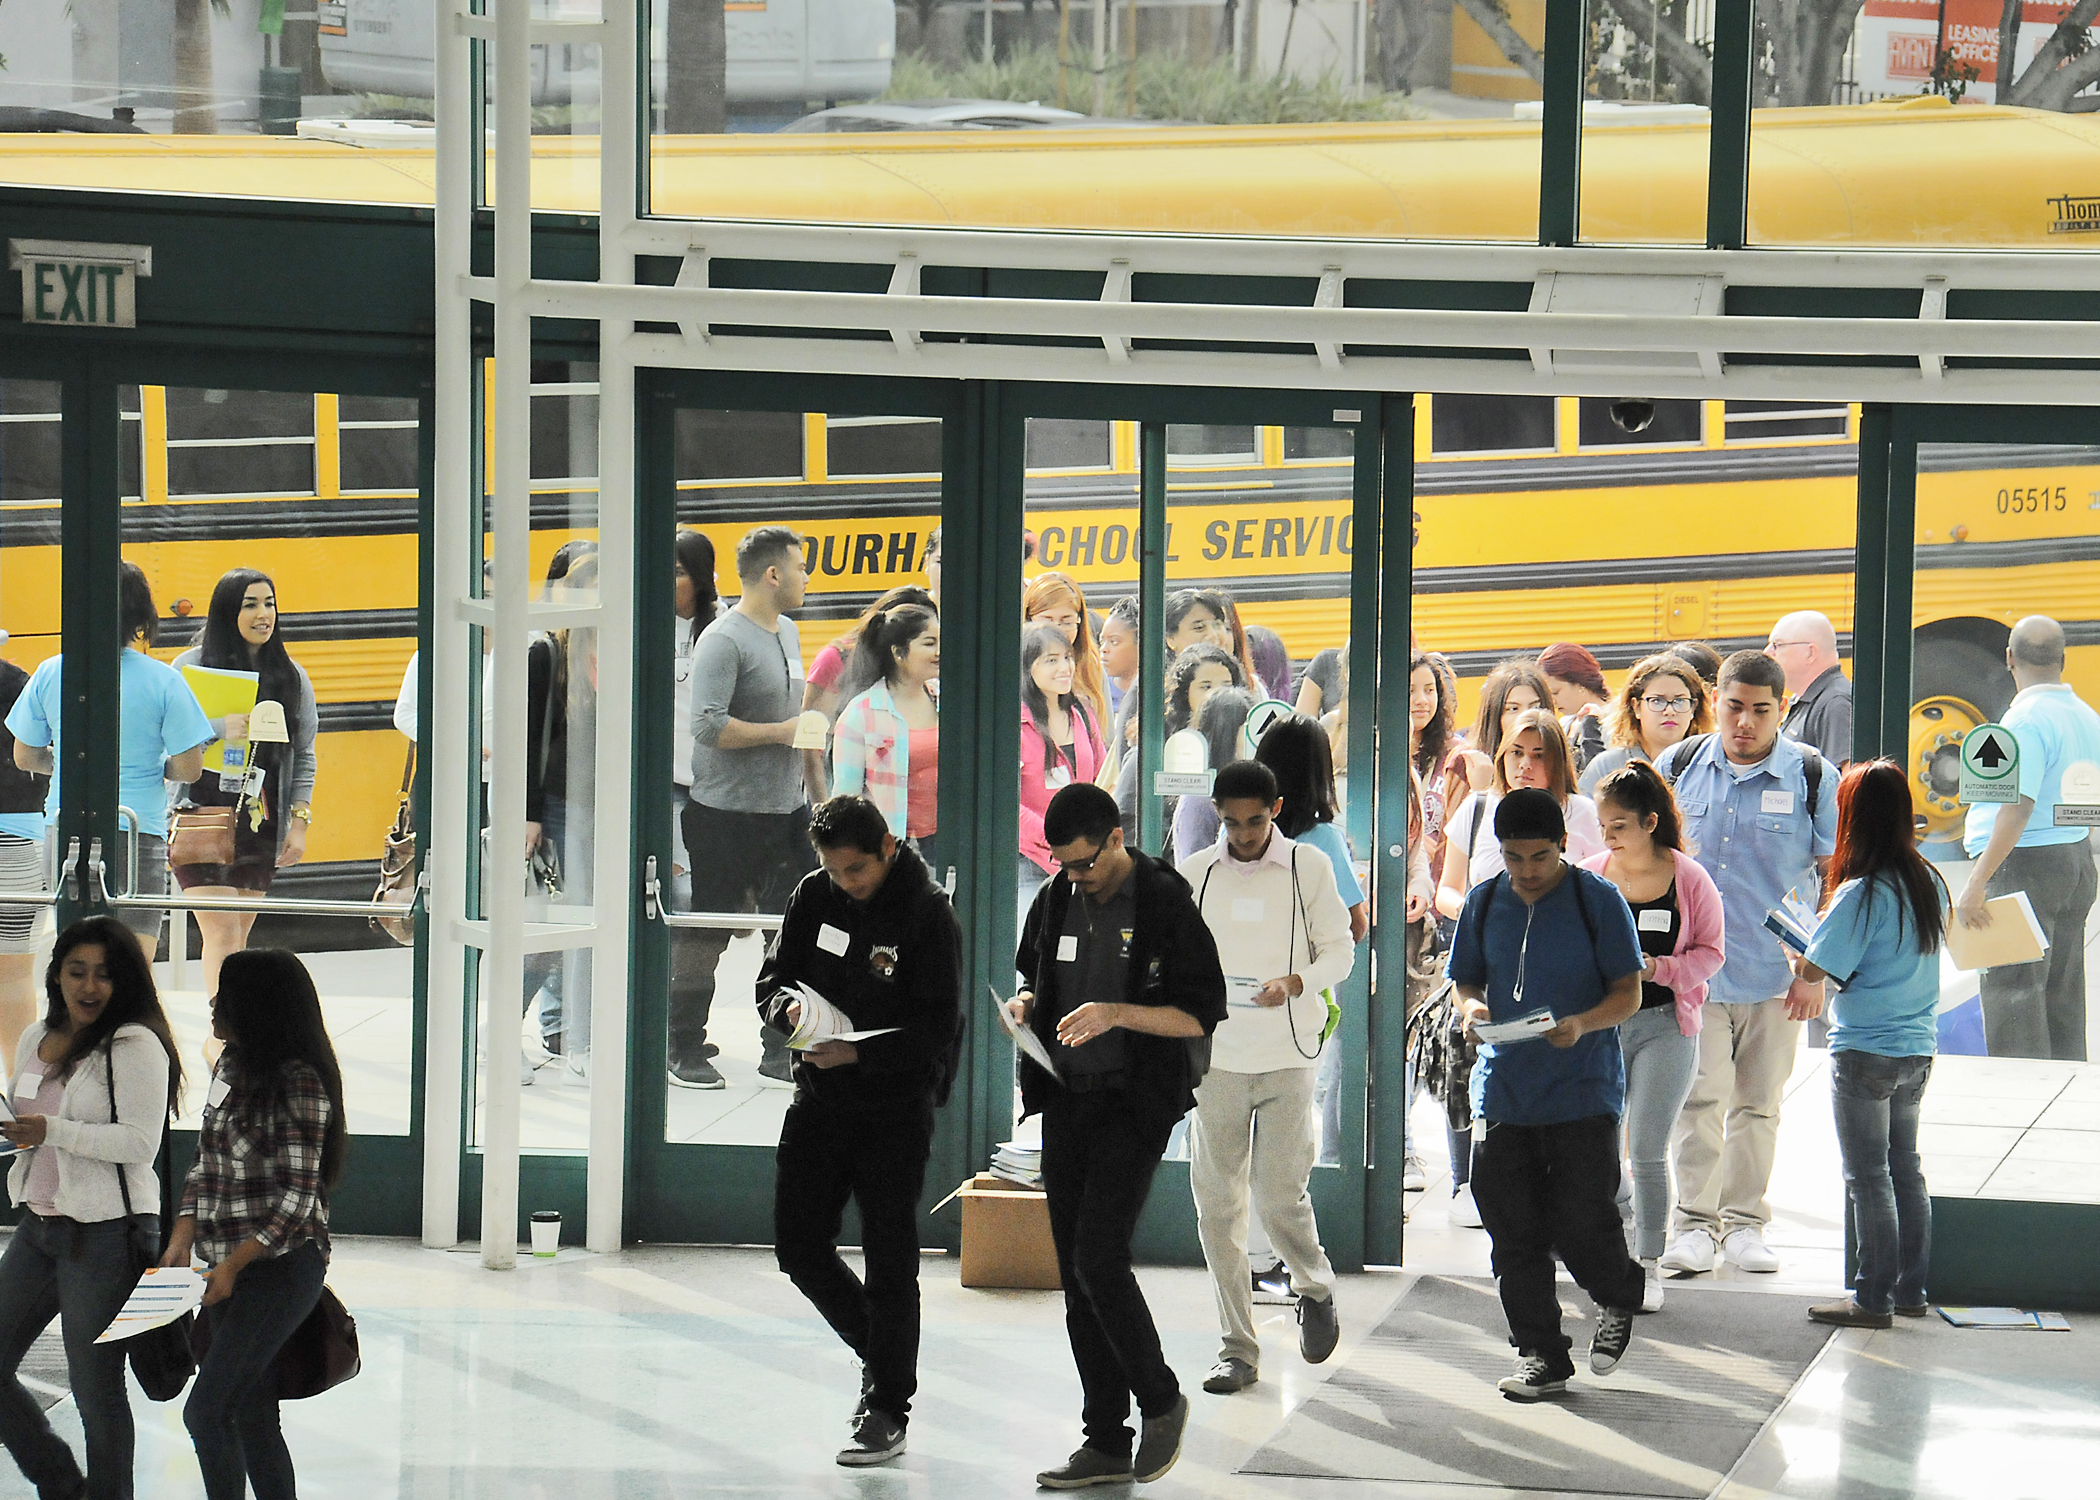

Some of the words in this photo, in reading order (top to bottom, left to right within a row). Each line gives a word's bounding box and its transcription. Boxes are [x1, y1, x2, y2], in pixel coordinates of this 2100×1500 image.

[1948, 25, 1999, 43] LEASING
[1951, 43, 1998, 62] OFFICE
[35, 263, 123, 323] EXIT
[1997, 487, 2066, 513] 05515
[1674, 596, 1699, 604] DIESEL
